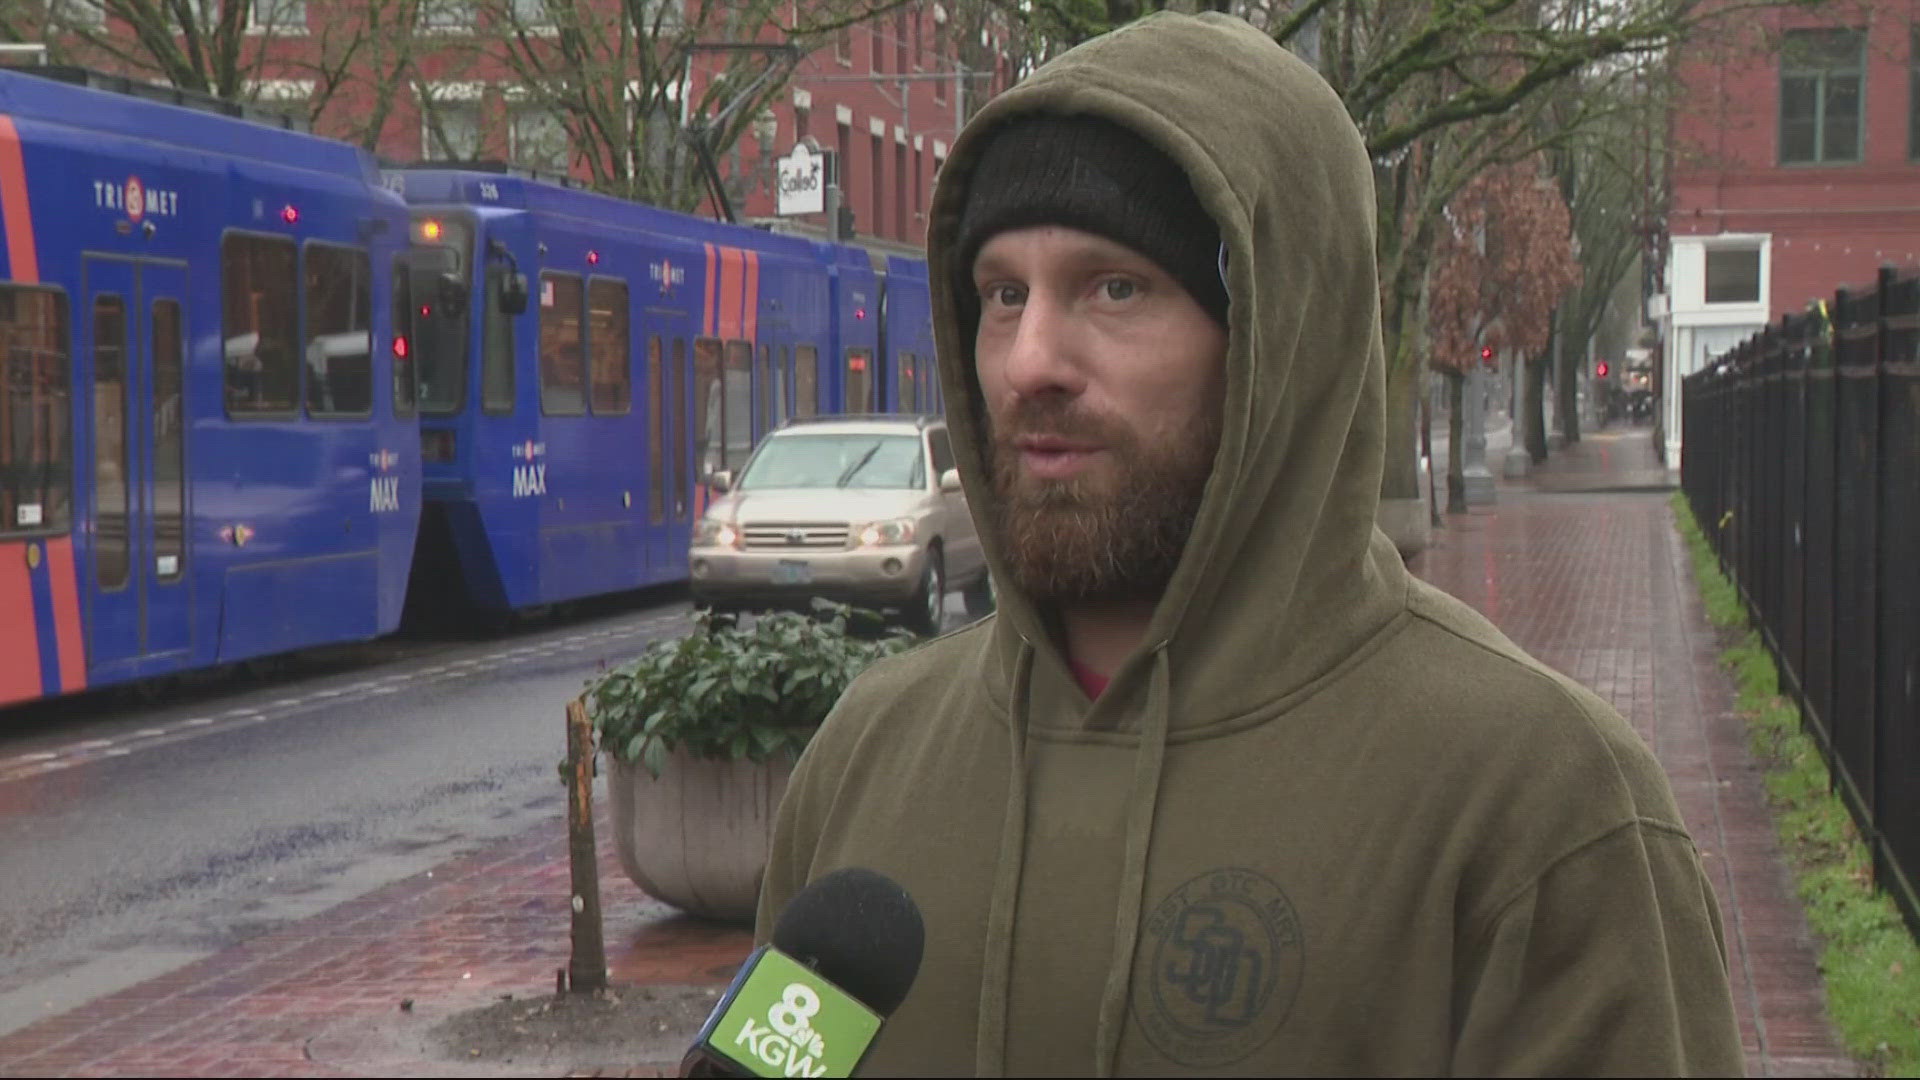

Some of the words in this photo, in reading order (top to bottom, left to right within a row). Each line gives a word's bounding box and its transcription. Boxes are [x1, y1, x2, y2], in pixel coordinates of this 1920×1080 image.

[370, 476, 399, 512] MAX
[513, 464, 546, 498] MAX
[768, 982, 820, 1038] 8
[734, 1017, 827, 1078] KGW
